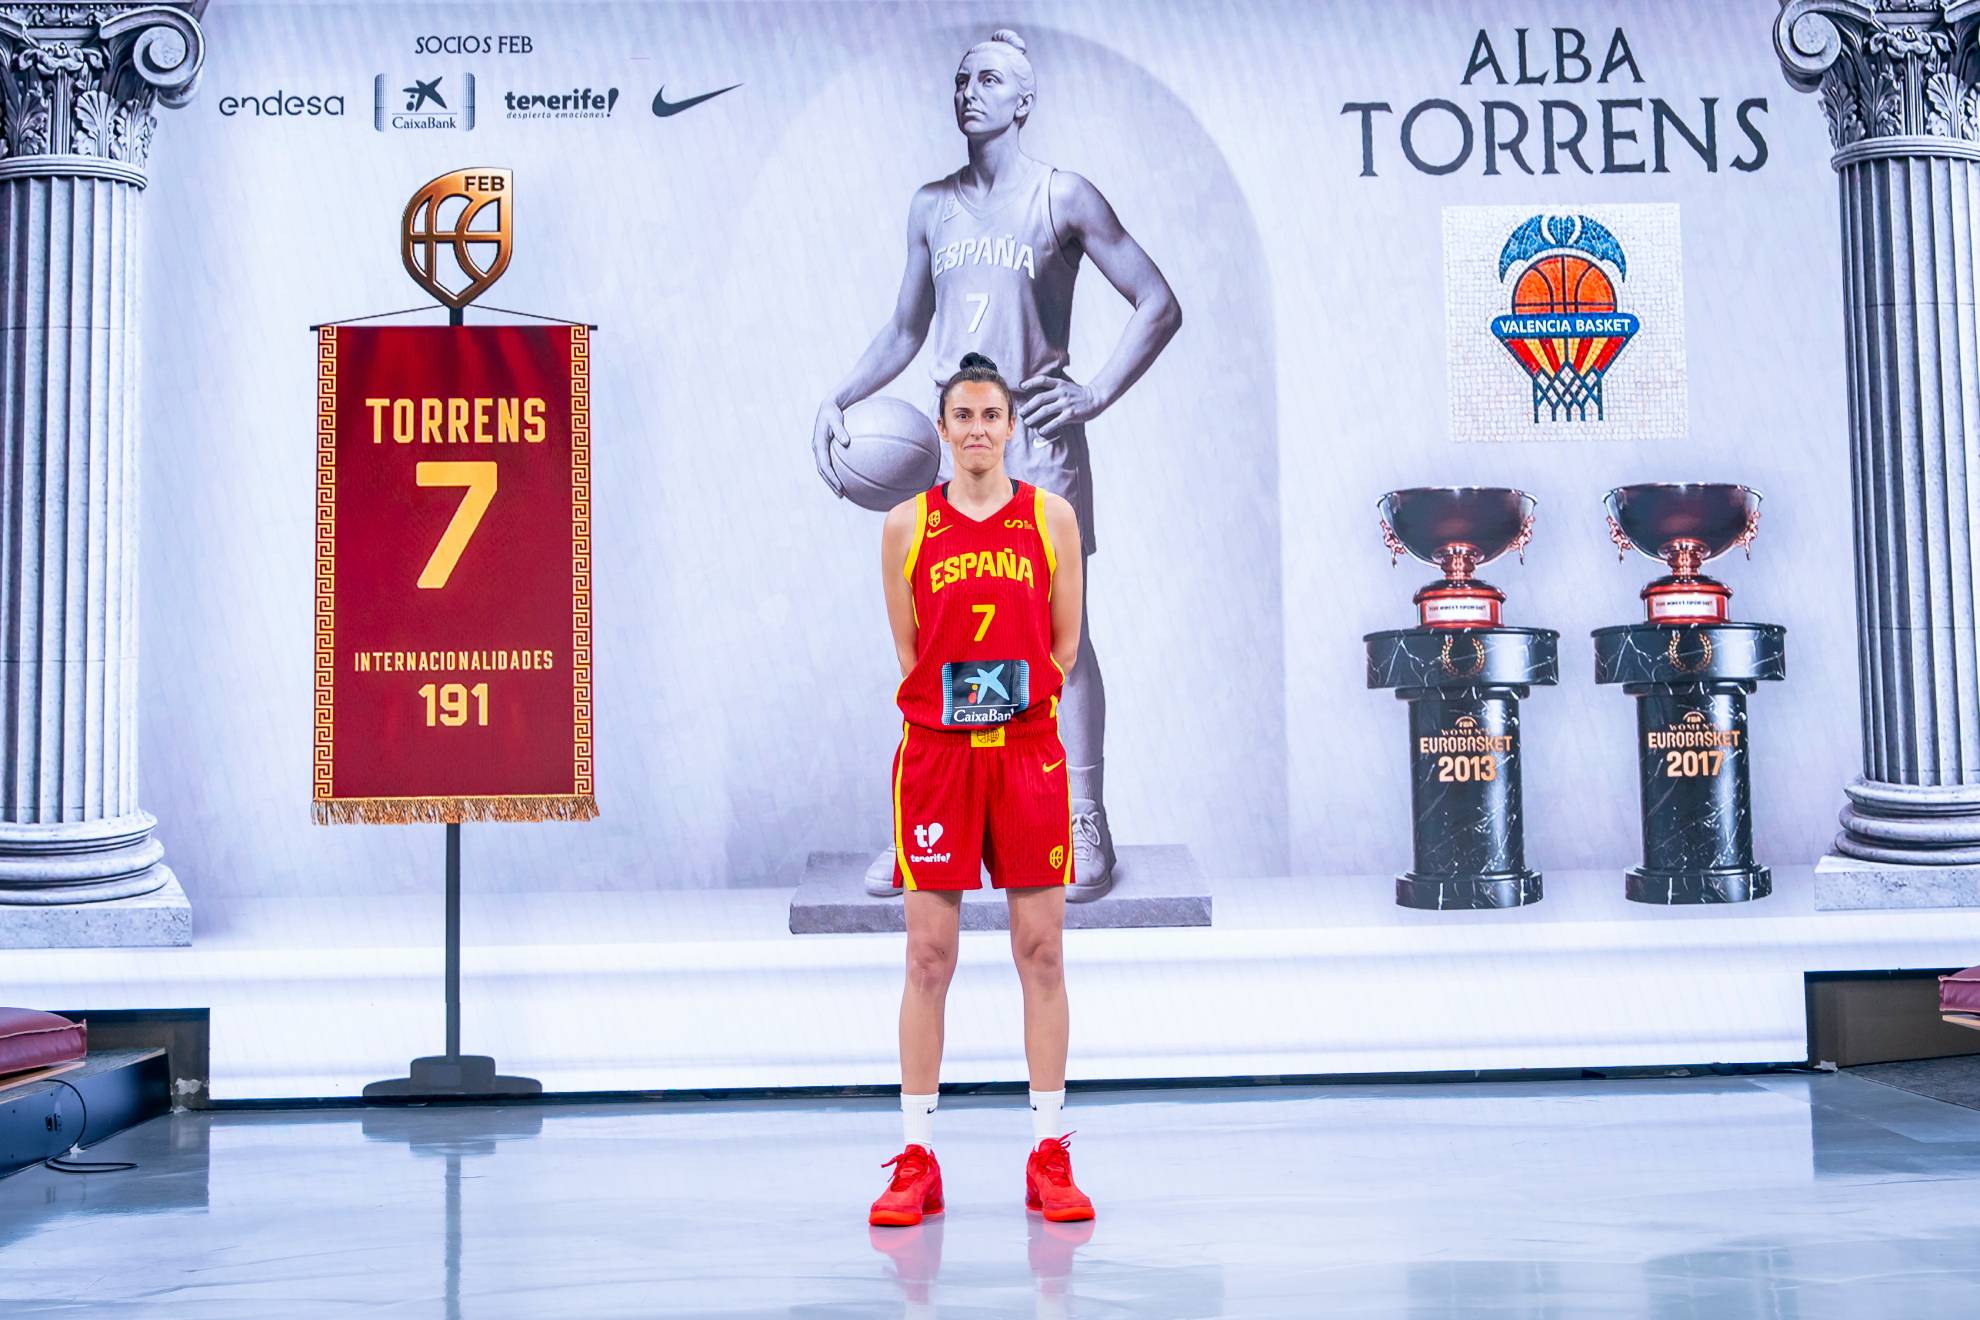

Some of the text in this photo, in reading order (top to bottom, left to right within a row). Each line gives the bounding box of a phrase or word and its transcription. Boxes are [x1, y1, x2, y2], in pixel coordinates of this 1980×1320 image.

[415, 36, 533, 54] SOCIOS FEB
[1460, 27, 1646, 86] ALBA
[219, 90, 344, 116] endesa
[555, 110, 605, 119] emociones
[392, 117, 457, 130] CaixaBank
[1340, 97, 1770, 177] TORRENS
[464, 175, 505, 192] FEB
[934, 234, 1036, 280] ESPAÑA
[966, 292, 990, 335] 7
[1500, 319, 1630, 334] VALENCIA BASKET
[365, 398, 546, 443] TORRENS
[416, 461, 498, 589] 7
[929, 547, 1035, 594] ESPAÑA
[971, 604, 996, 642] 7
[354, 650, 553, 672] INTERNACIONALIDADES
[418, 683, 489, 727] 191
[1420, 736, 1513, 753] EUROBASKET
[1648, 730, 1741, 749] EUROBASKET
[1438, 755, 1497, 783] 2013
[1666, 750, 1725, 777] 2017
